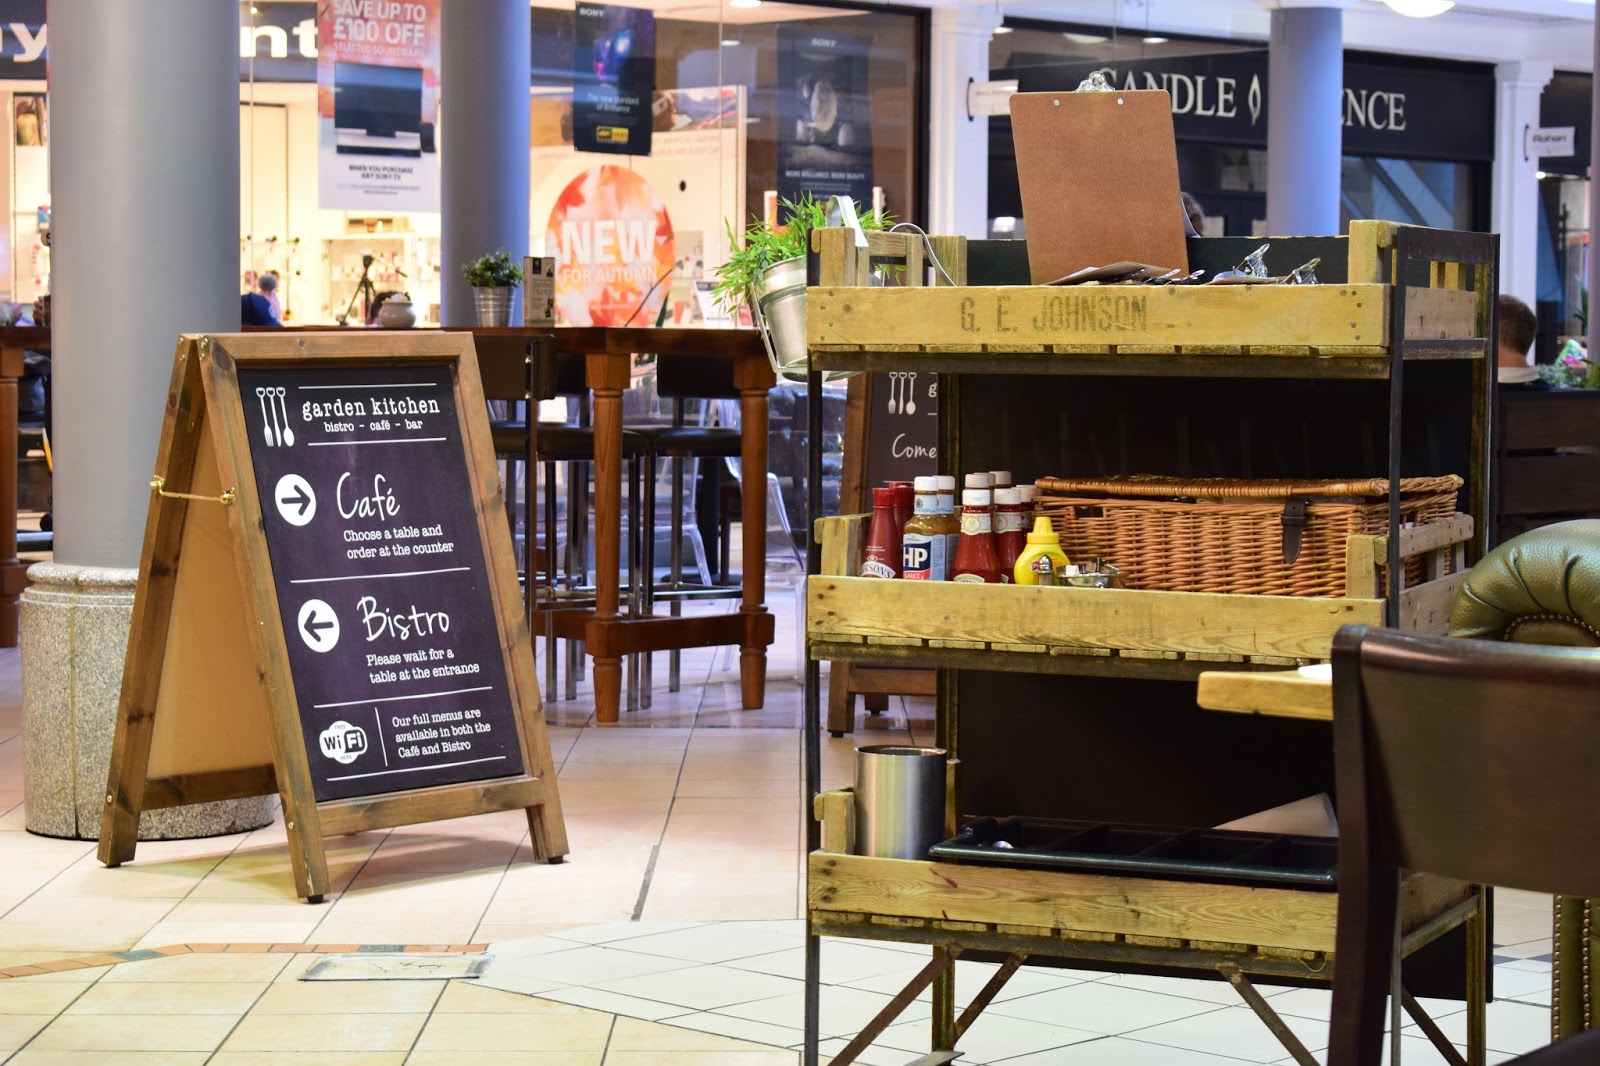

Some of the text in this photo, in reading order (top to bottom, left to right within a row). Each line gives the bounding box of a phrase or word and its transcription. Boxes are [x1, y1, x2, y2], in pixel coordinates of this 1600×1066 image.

[334, 0, 427, 22] SAVE UP TO
[579, 7, 605, 18] SONY
[334, 17, 426, 46] £100 OFF
[0, 23, 47, 62] y
[334, 41, 372, 54] SELECTED
[811, 37, 838, 48] SONY
[1341, 88, 1407, 131] NCE
[349, 164, 367, 172] WHEN
[382, 166, 413, 174] PURCHASE
[562, 219, 658, 265] NEW
[562, 267, 658, 284] FOR AUTUMN
[1033, 295, 1148, 332] JOHNSON
[302, 397, 440, 421] garden kitchen
[324, 422, 354, 433] bistro
[370, 420, 391, 431] café
[405, 419, 423, 430] bar
[892, 433, 937, 459] Come
[337, 472, 401, 521] Café
[344, 524, 443, 542] Choose a table and
[347, 541, 454, 559] order at the counter
[903, 546, 928, 568] HP
[357, 596, 449, 641] Bistro
[366, 649, 454, 666] Please wait for a
[369, 662, 480, 684] table at the entrance
[392, 709, 481, 727] Our full menus are
[396, 722, 491, 743] available in both the
[398, 740, 471, 759] Café and Bistro
